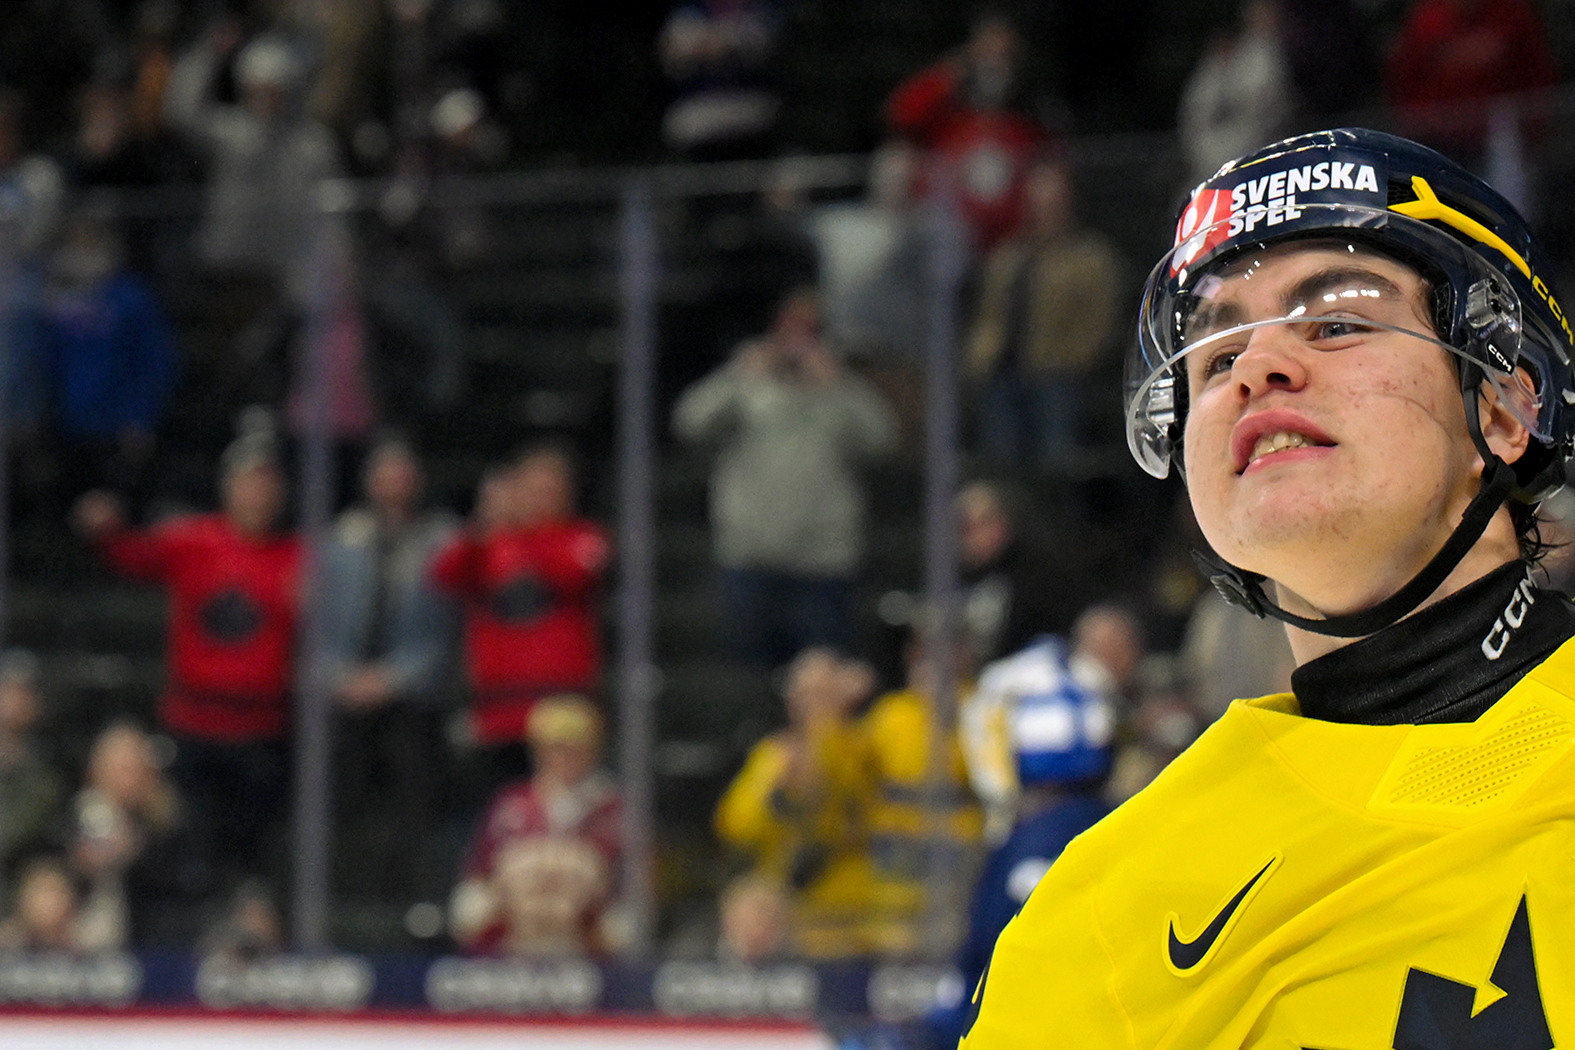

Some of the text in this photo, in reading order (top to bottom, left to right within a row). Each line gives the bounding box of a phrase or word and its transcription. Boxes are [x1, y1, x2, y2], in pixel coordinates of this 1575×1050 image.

[1230, 161, 1379, 211] SVENSKA
[1227, 194, 1302, 237] SPEL
[1532, 275, 1574, 346] CCM
[1488, 344, 1512, 372] CCM
[1481, 565, 1539, 661] CCM
